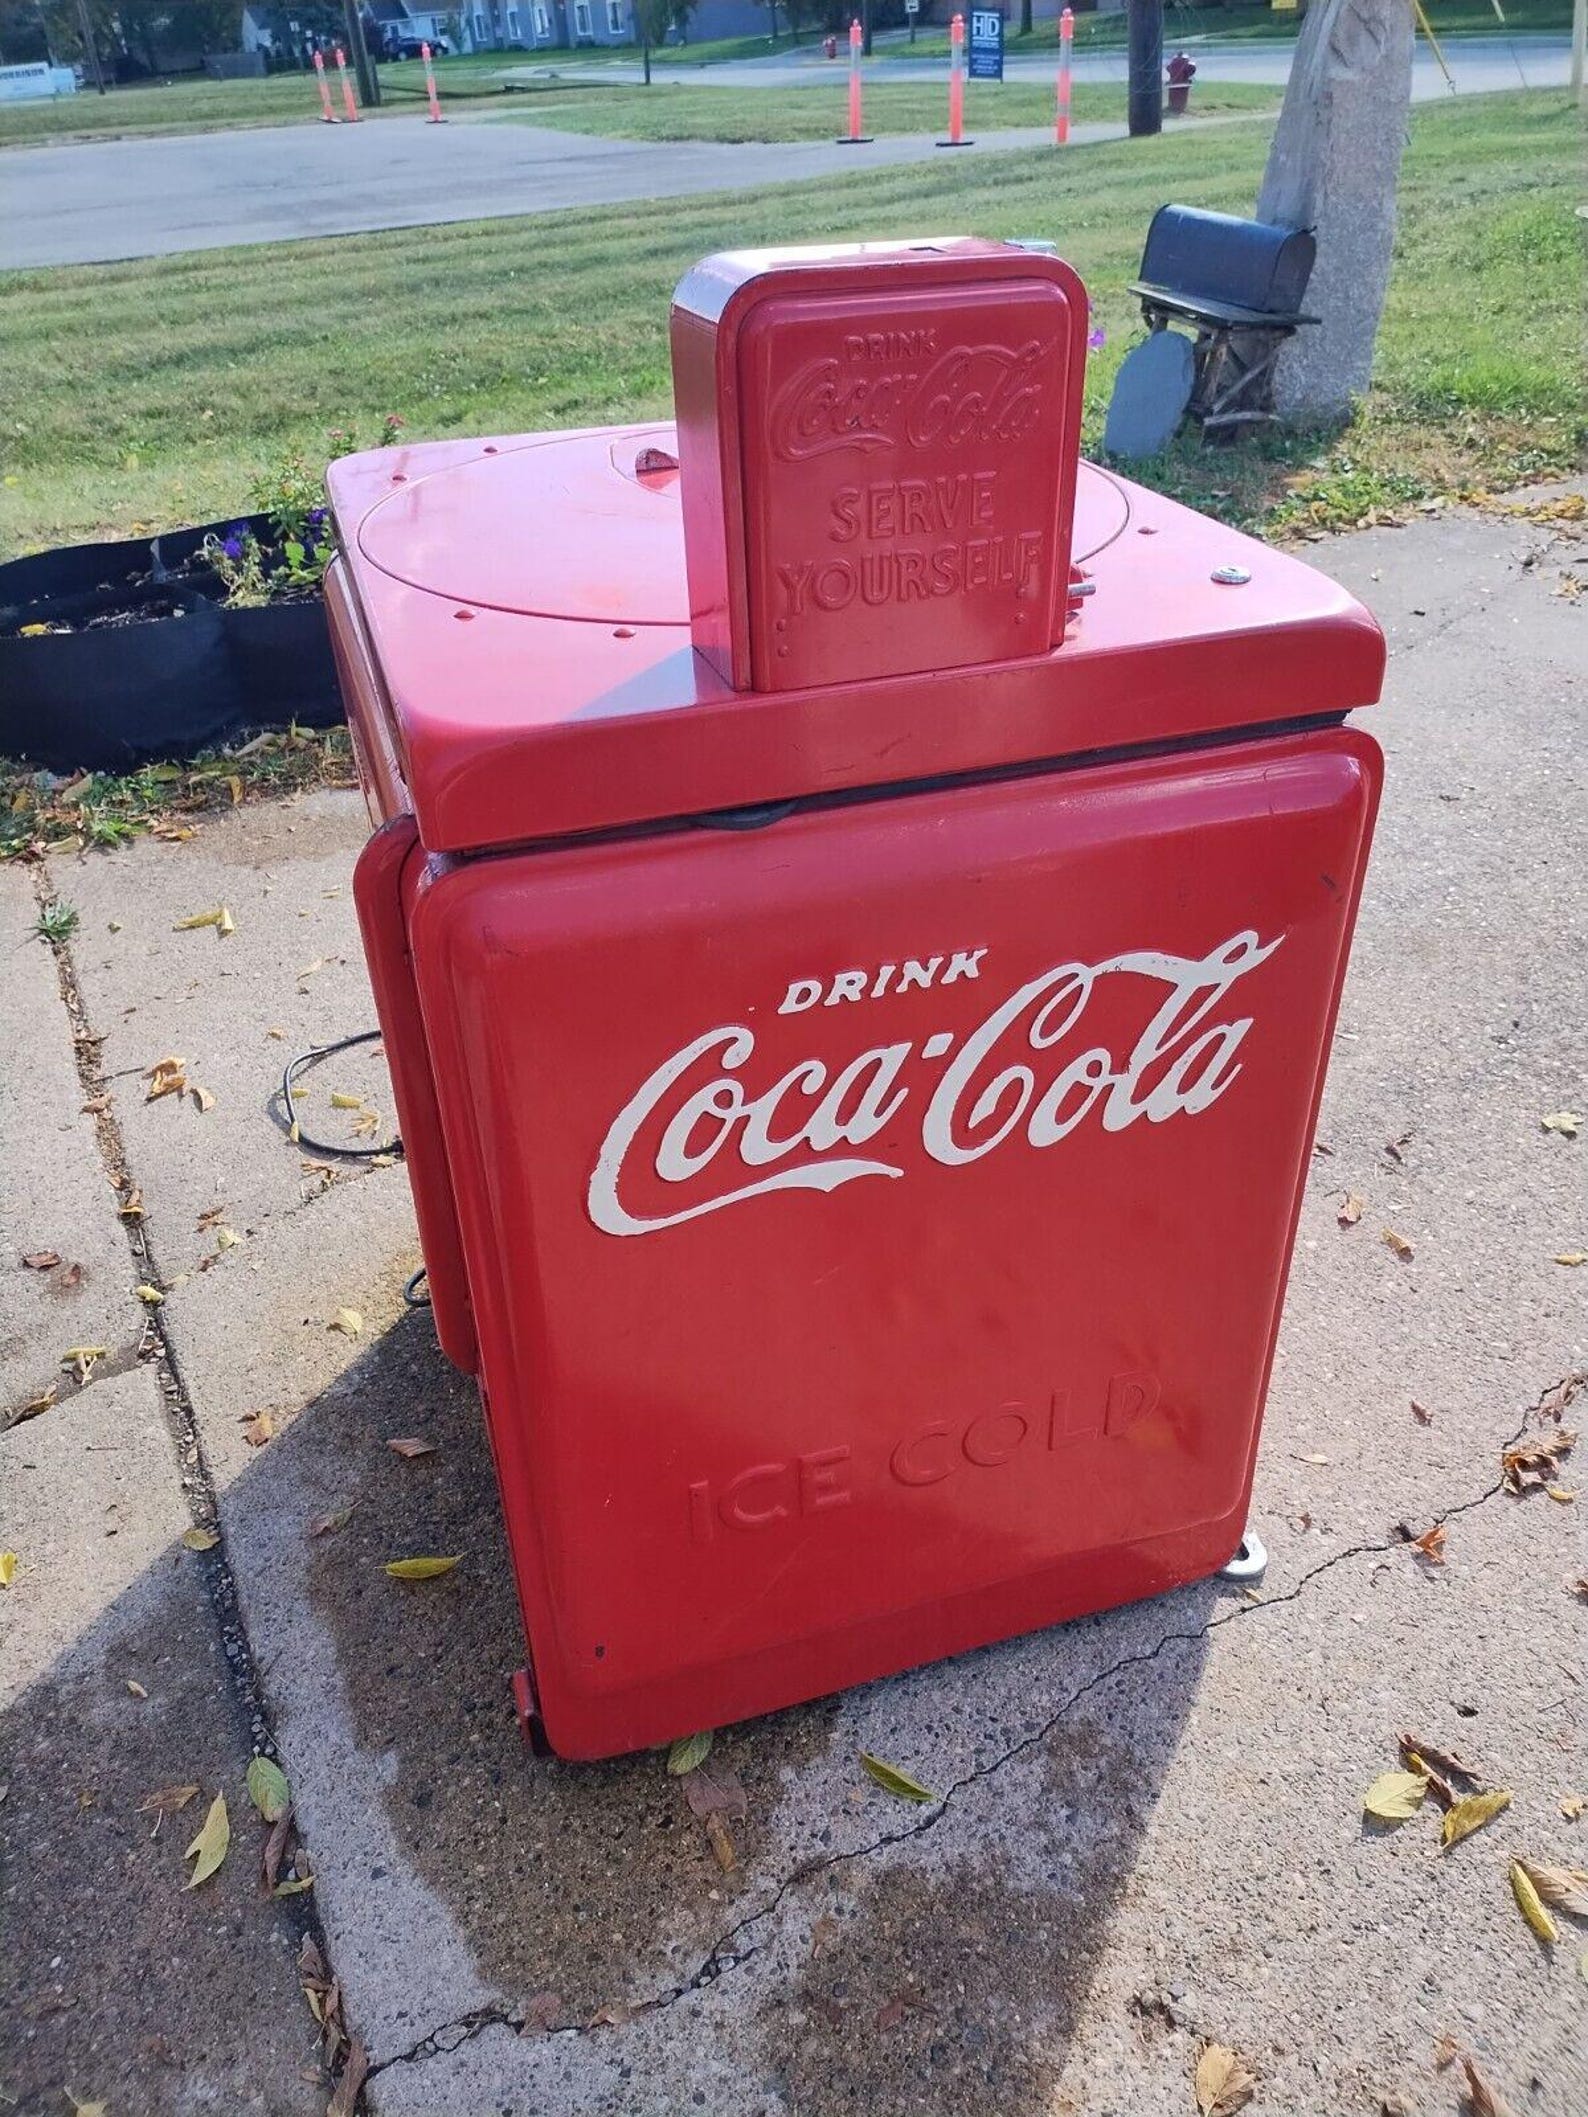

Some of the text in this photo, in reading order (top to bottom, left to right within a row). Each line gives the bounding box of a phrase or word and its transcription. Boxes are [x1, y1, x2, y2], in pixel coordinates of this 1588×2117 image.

[845, 330, 937, 360] DRINK
[830, 471, 997, 543] SERVE
[779, 532, 1043, 615] YOURSELF
[778, 949, 989, 1014] DRINK
[587, 929, 1288, 1237] Coca-Cola
[688, 1371, 1162, 1544] ICE COLD
